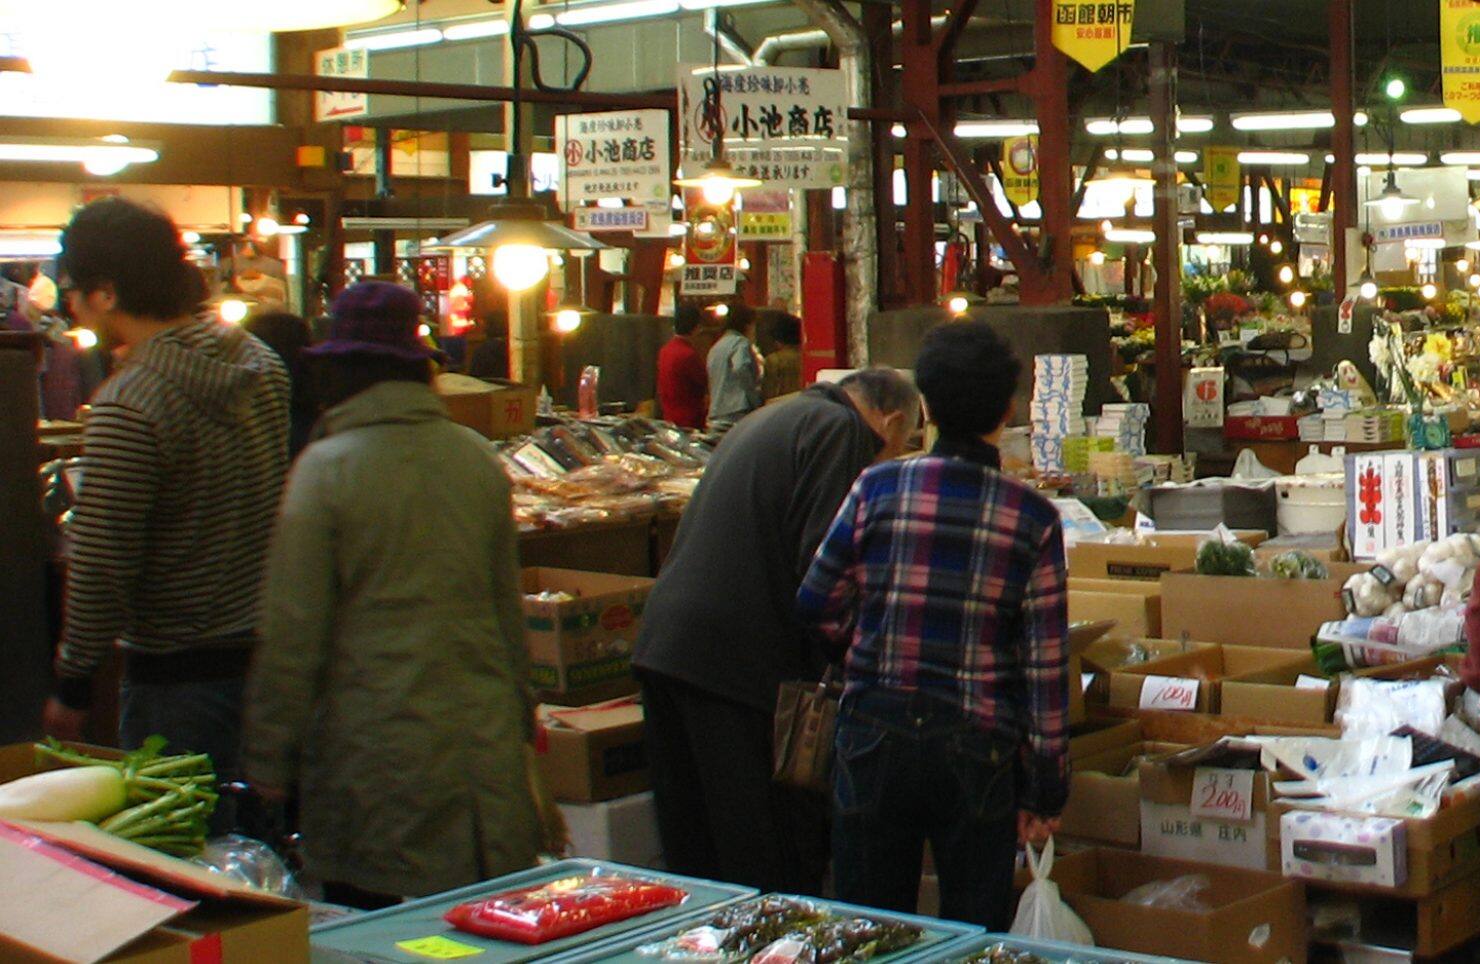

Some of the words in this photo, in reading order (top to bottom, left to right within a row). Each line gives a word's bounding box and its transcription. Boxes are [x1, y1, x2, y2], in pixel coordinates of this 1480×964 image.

[1057, 3, 1133, 24] 函館朝市
[732, 103, 833, 138] 小池商店
[586, 135, 655, 164] 小池商店
